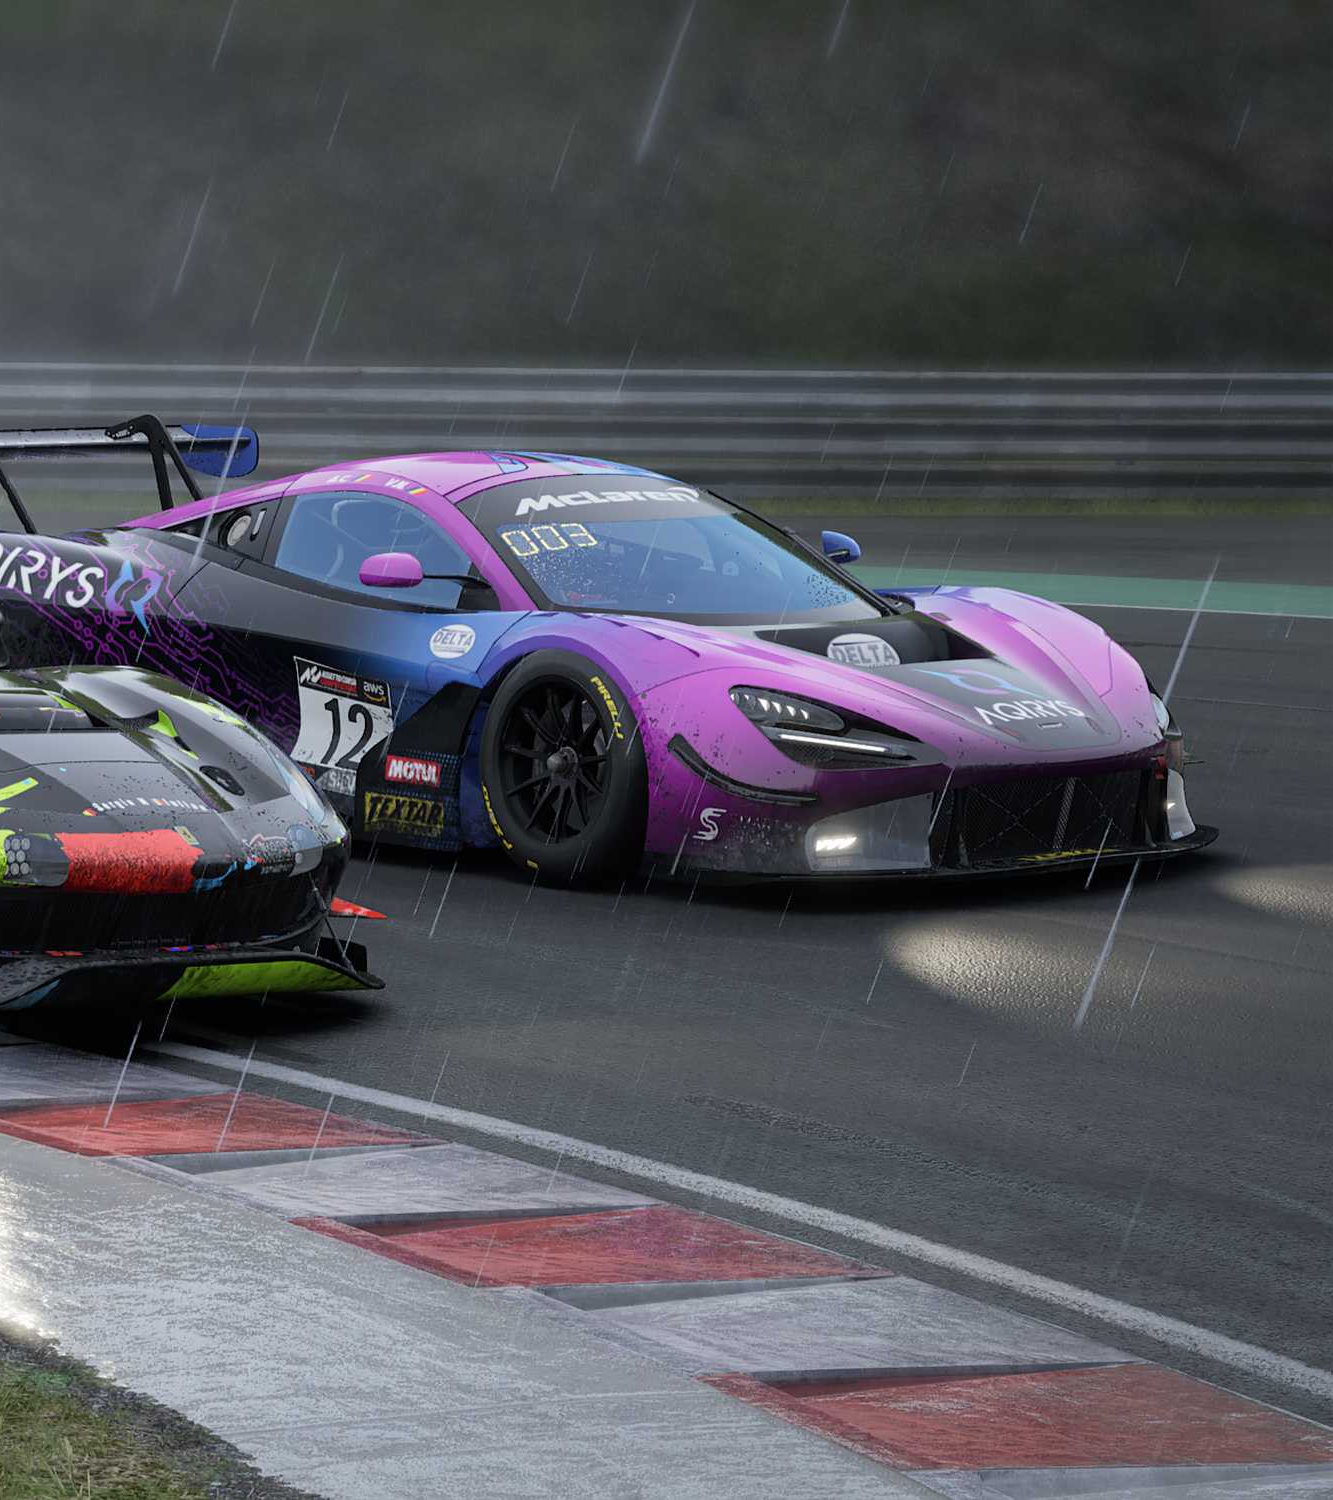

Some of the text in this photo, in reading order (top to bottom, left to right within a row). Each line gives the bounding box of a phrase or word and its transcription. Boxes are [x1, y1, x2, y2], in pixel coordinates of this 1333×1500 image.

[515, 488, 700, 516] McLaren
[501, 523, 598, 557] 003
[433, 630, 474, 646] DELTA
[830, 642, 897, 664] DELTA
[363, 681, 385, 695] aws
[590, 676, 624, 740] PIRELLI
[974, 699, 1086, 726] AQIRYS
[321, 698, 374, 769] 12
[329, 770, 357, 790] SILV
[388, 759, 438, 784] MOTUL
[367, 795, 443, 826] TEXTAR
